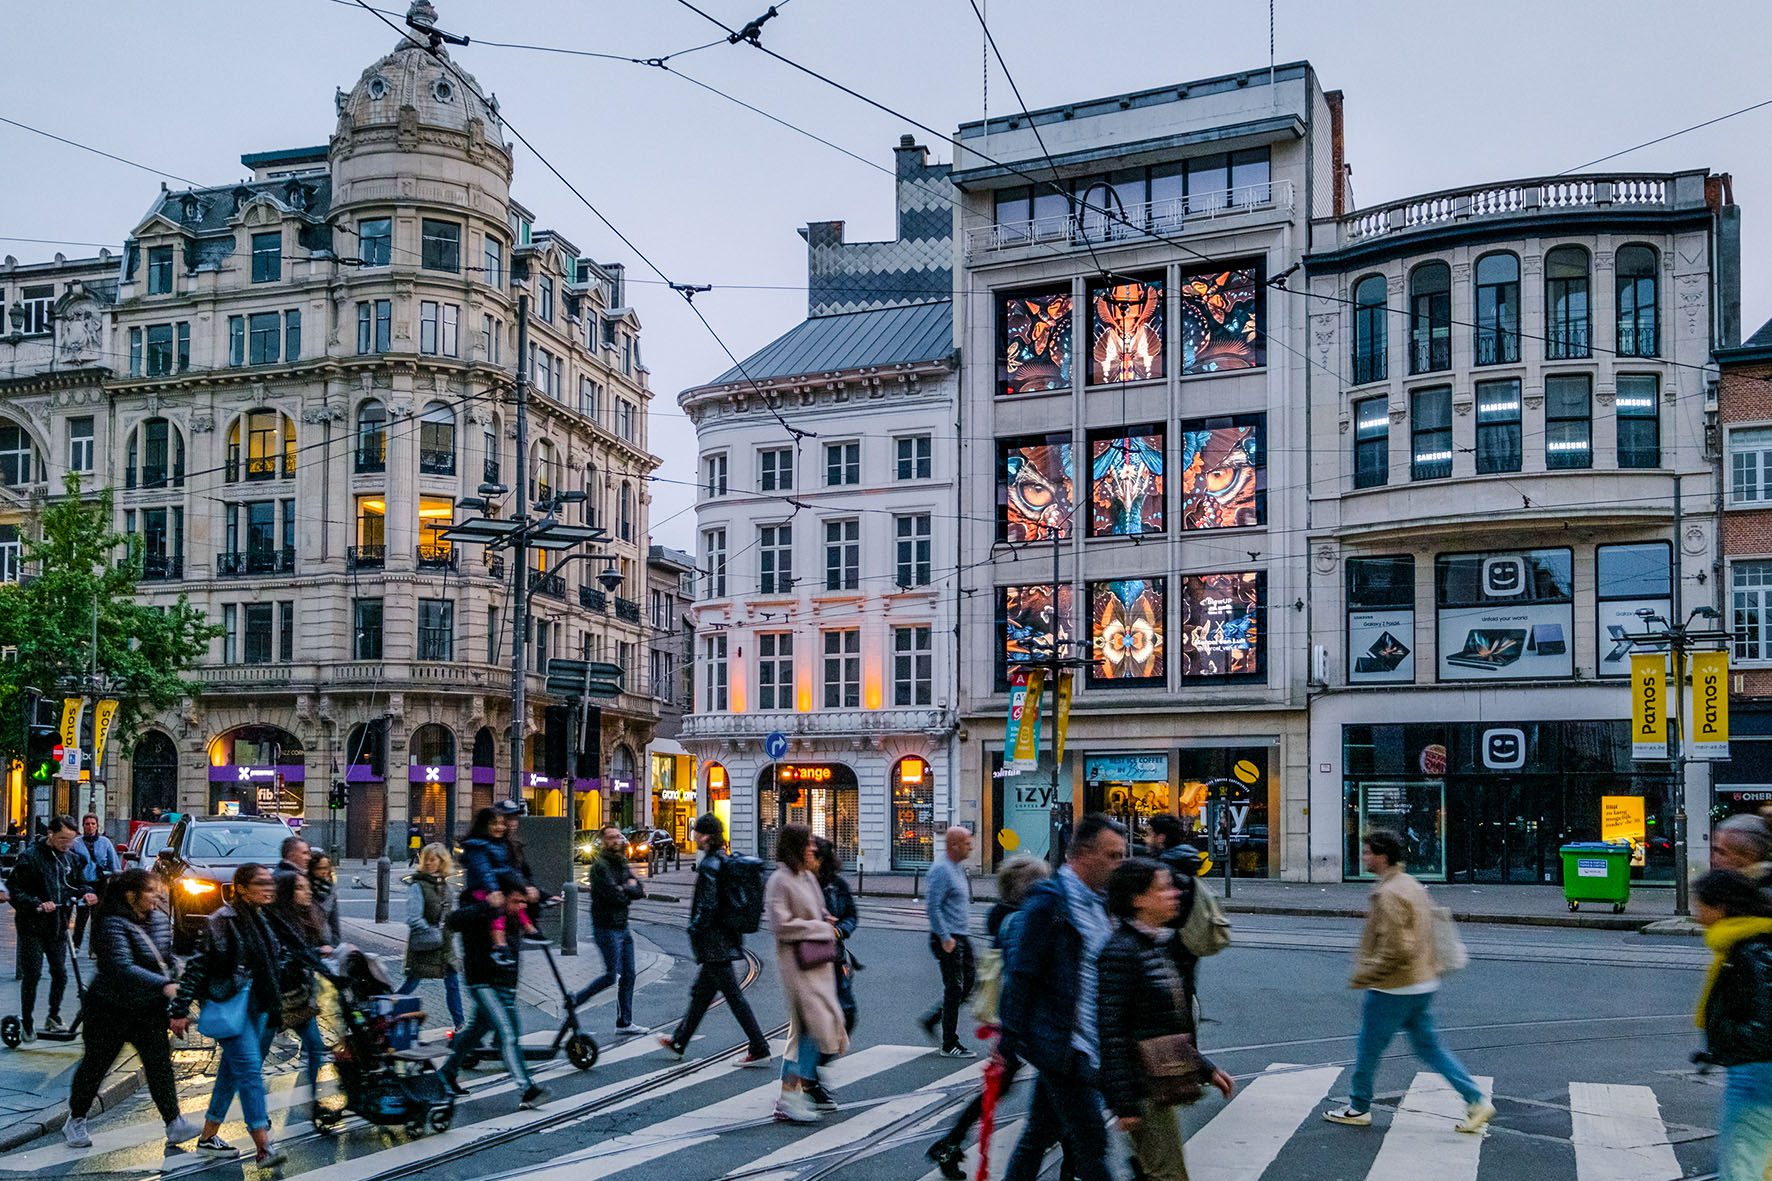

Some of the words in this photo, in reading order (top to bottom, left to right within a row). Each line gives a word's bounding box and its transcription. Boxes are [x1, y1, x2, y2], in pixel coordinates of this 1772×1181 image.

[1480, 402, 1518, 412] SAMSUNG
[1616, 399, 1652, 407] SAMSUNG
[1549, 441, 1587, 450] SAMSUNG
[1416, 451, 1452, 462] SAMSUNG
[1642, 677, 1656, 734] Panos
[1703, 675, 1717, 733] Panos
[65, 708, 77, 748] anos
[1198, 806, 1250, 833] iy
